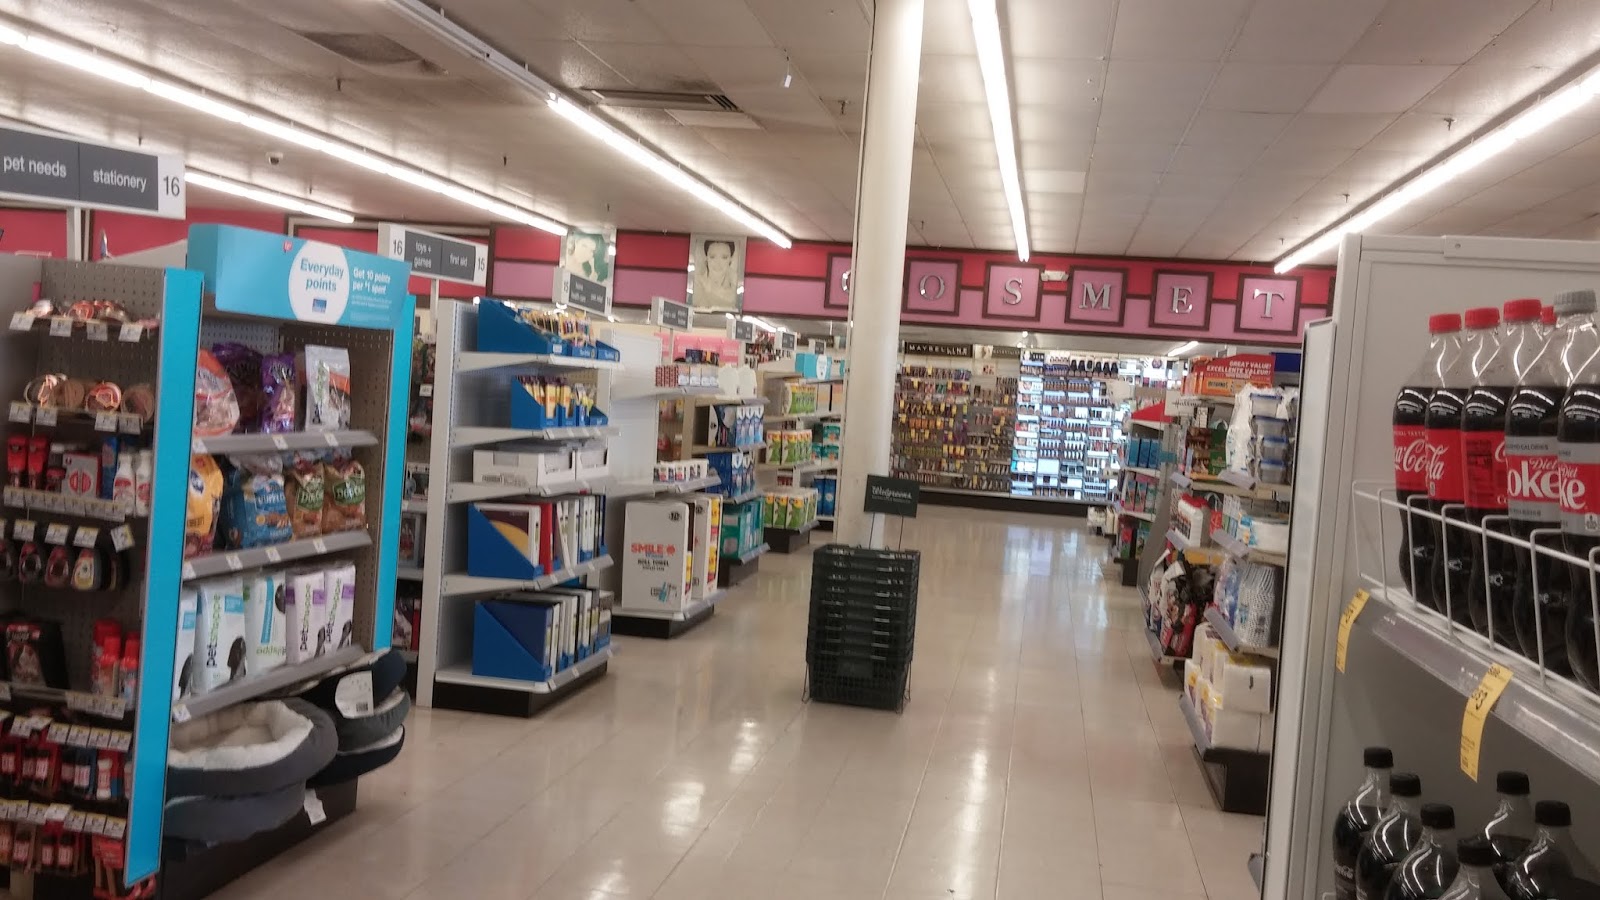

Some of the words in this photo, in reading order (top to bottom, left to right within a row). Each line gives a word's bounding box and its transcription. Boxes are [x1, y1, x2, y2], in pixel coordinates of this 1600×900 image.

[3, 155, 25, 173] pet
[29, 160, 67, 178] needs
[93, 168, 147, 193] stationery
[163, 176, 180, 197] 16
[393, 239, 403, 255] 16
[416, 241, 427, 255] toys
[414, 256, 432, 269] games
[450, 252, 460, 266] first
[460, 256, 468, 267] aid
[478, 257, 485, 271] 15
[300, 258, 344, 279] Everyday
[353, 267, 365, 279] Get
[367, 268, 373, 280] 10
[374, 271, 391, 285] points
[305, 277, 337, 293] points
[352, 281, 363, 292] per
[371, 284, 387, 295] spent
[1229, 360, 1249, 368] GREAT
[1529, 458, 1558, 471] Diet
[1561, 463, 1578, 478] Diet
[1507, 460, 1560, 498] oke
[631, 543, 663, 554] SMILE
[206, 592, 221, 668] petshoppe
